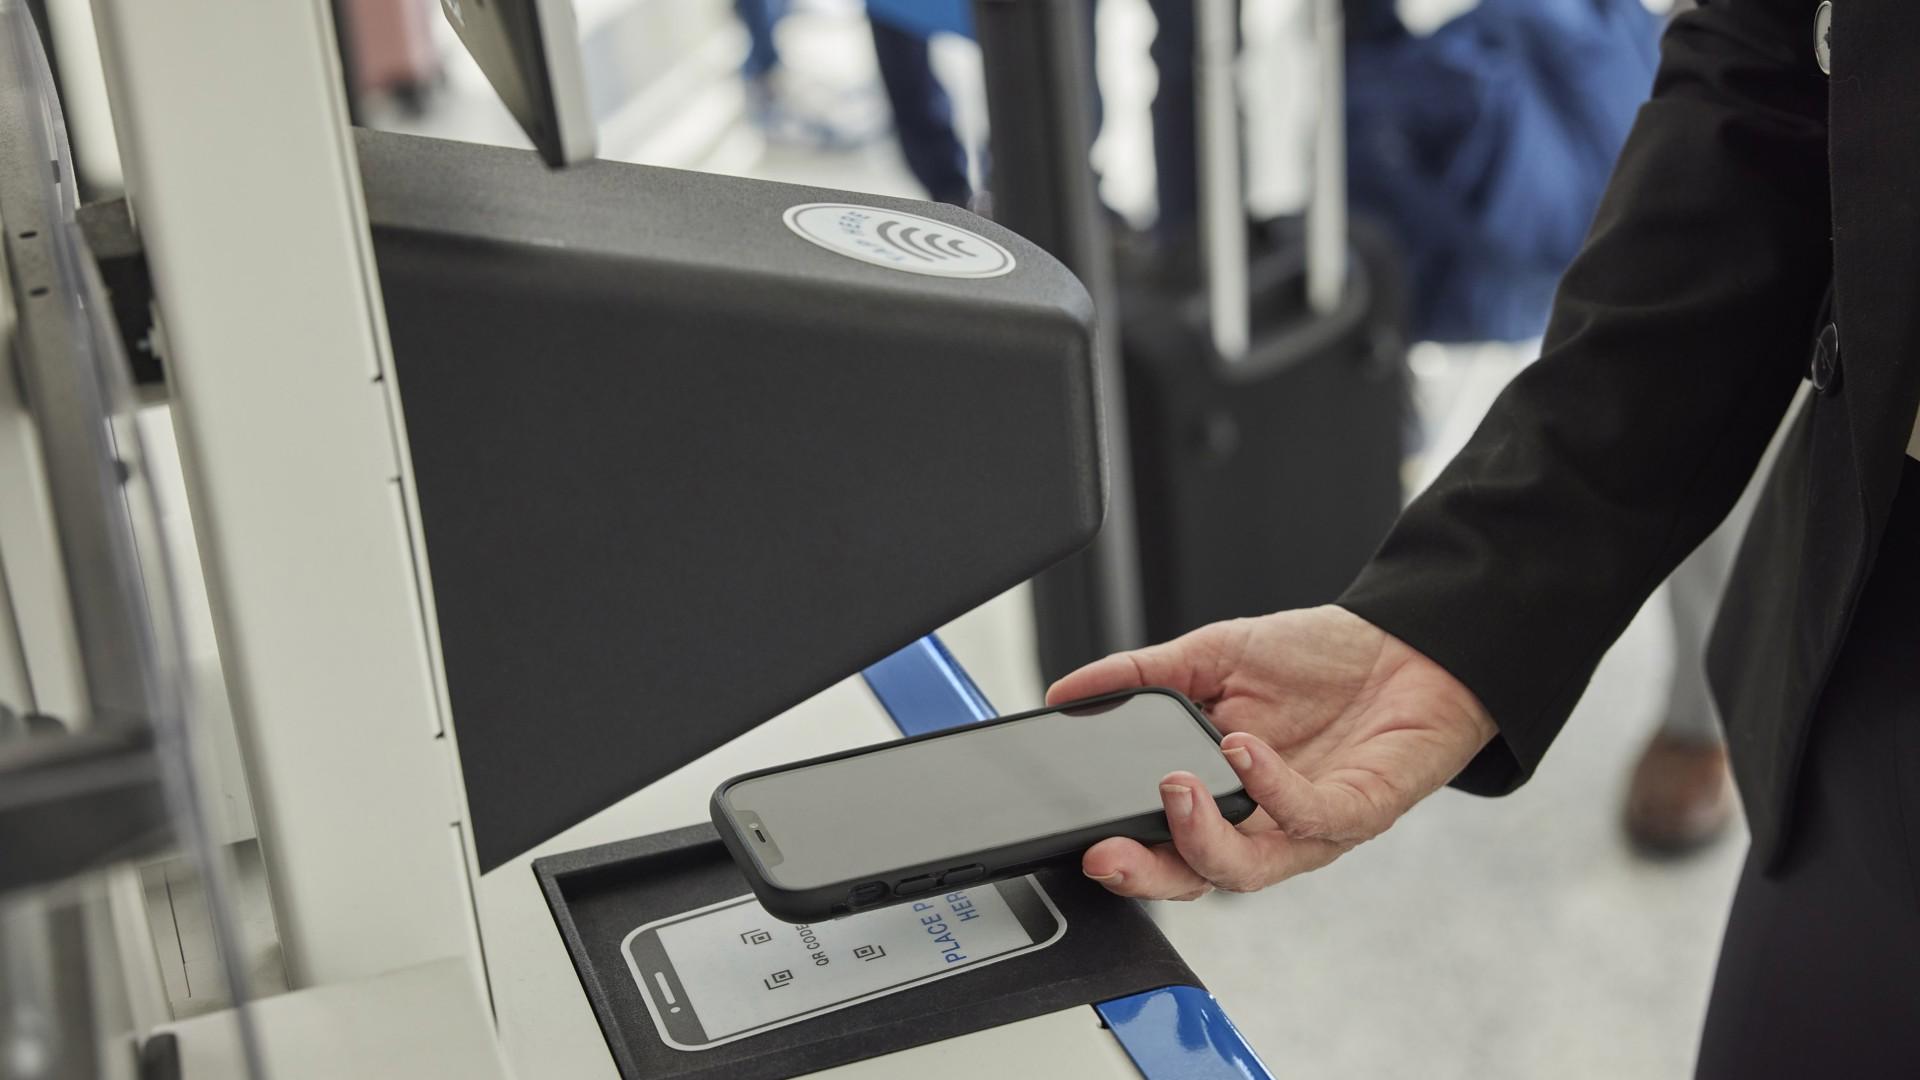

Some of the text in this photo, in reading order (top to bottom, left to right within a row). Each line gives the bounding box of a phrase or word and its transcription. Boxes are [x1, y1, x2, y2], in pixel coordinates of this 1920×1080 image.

[945, 890, 981, 922] HER
[795, 923, 830, 967] QR CODE
[920, 913, 967, 964] PLACE
